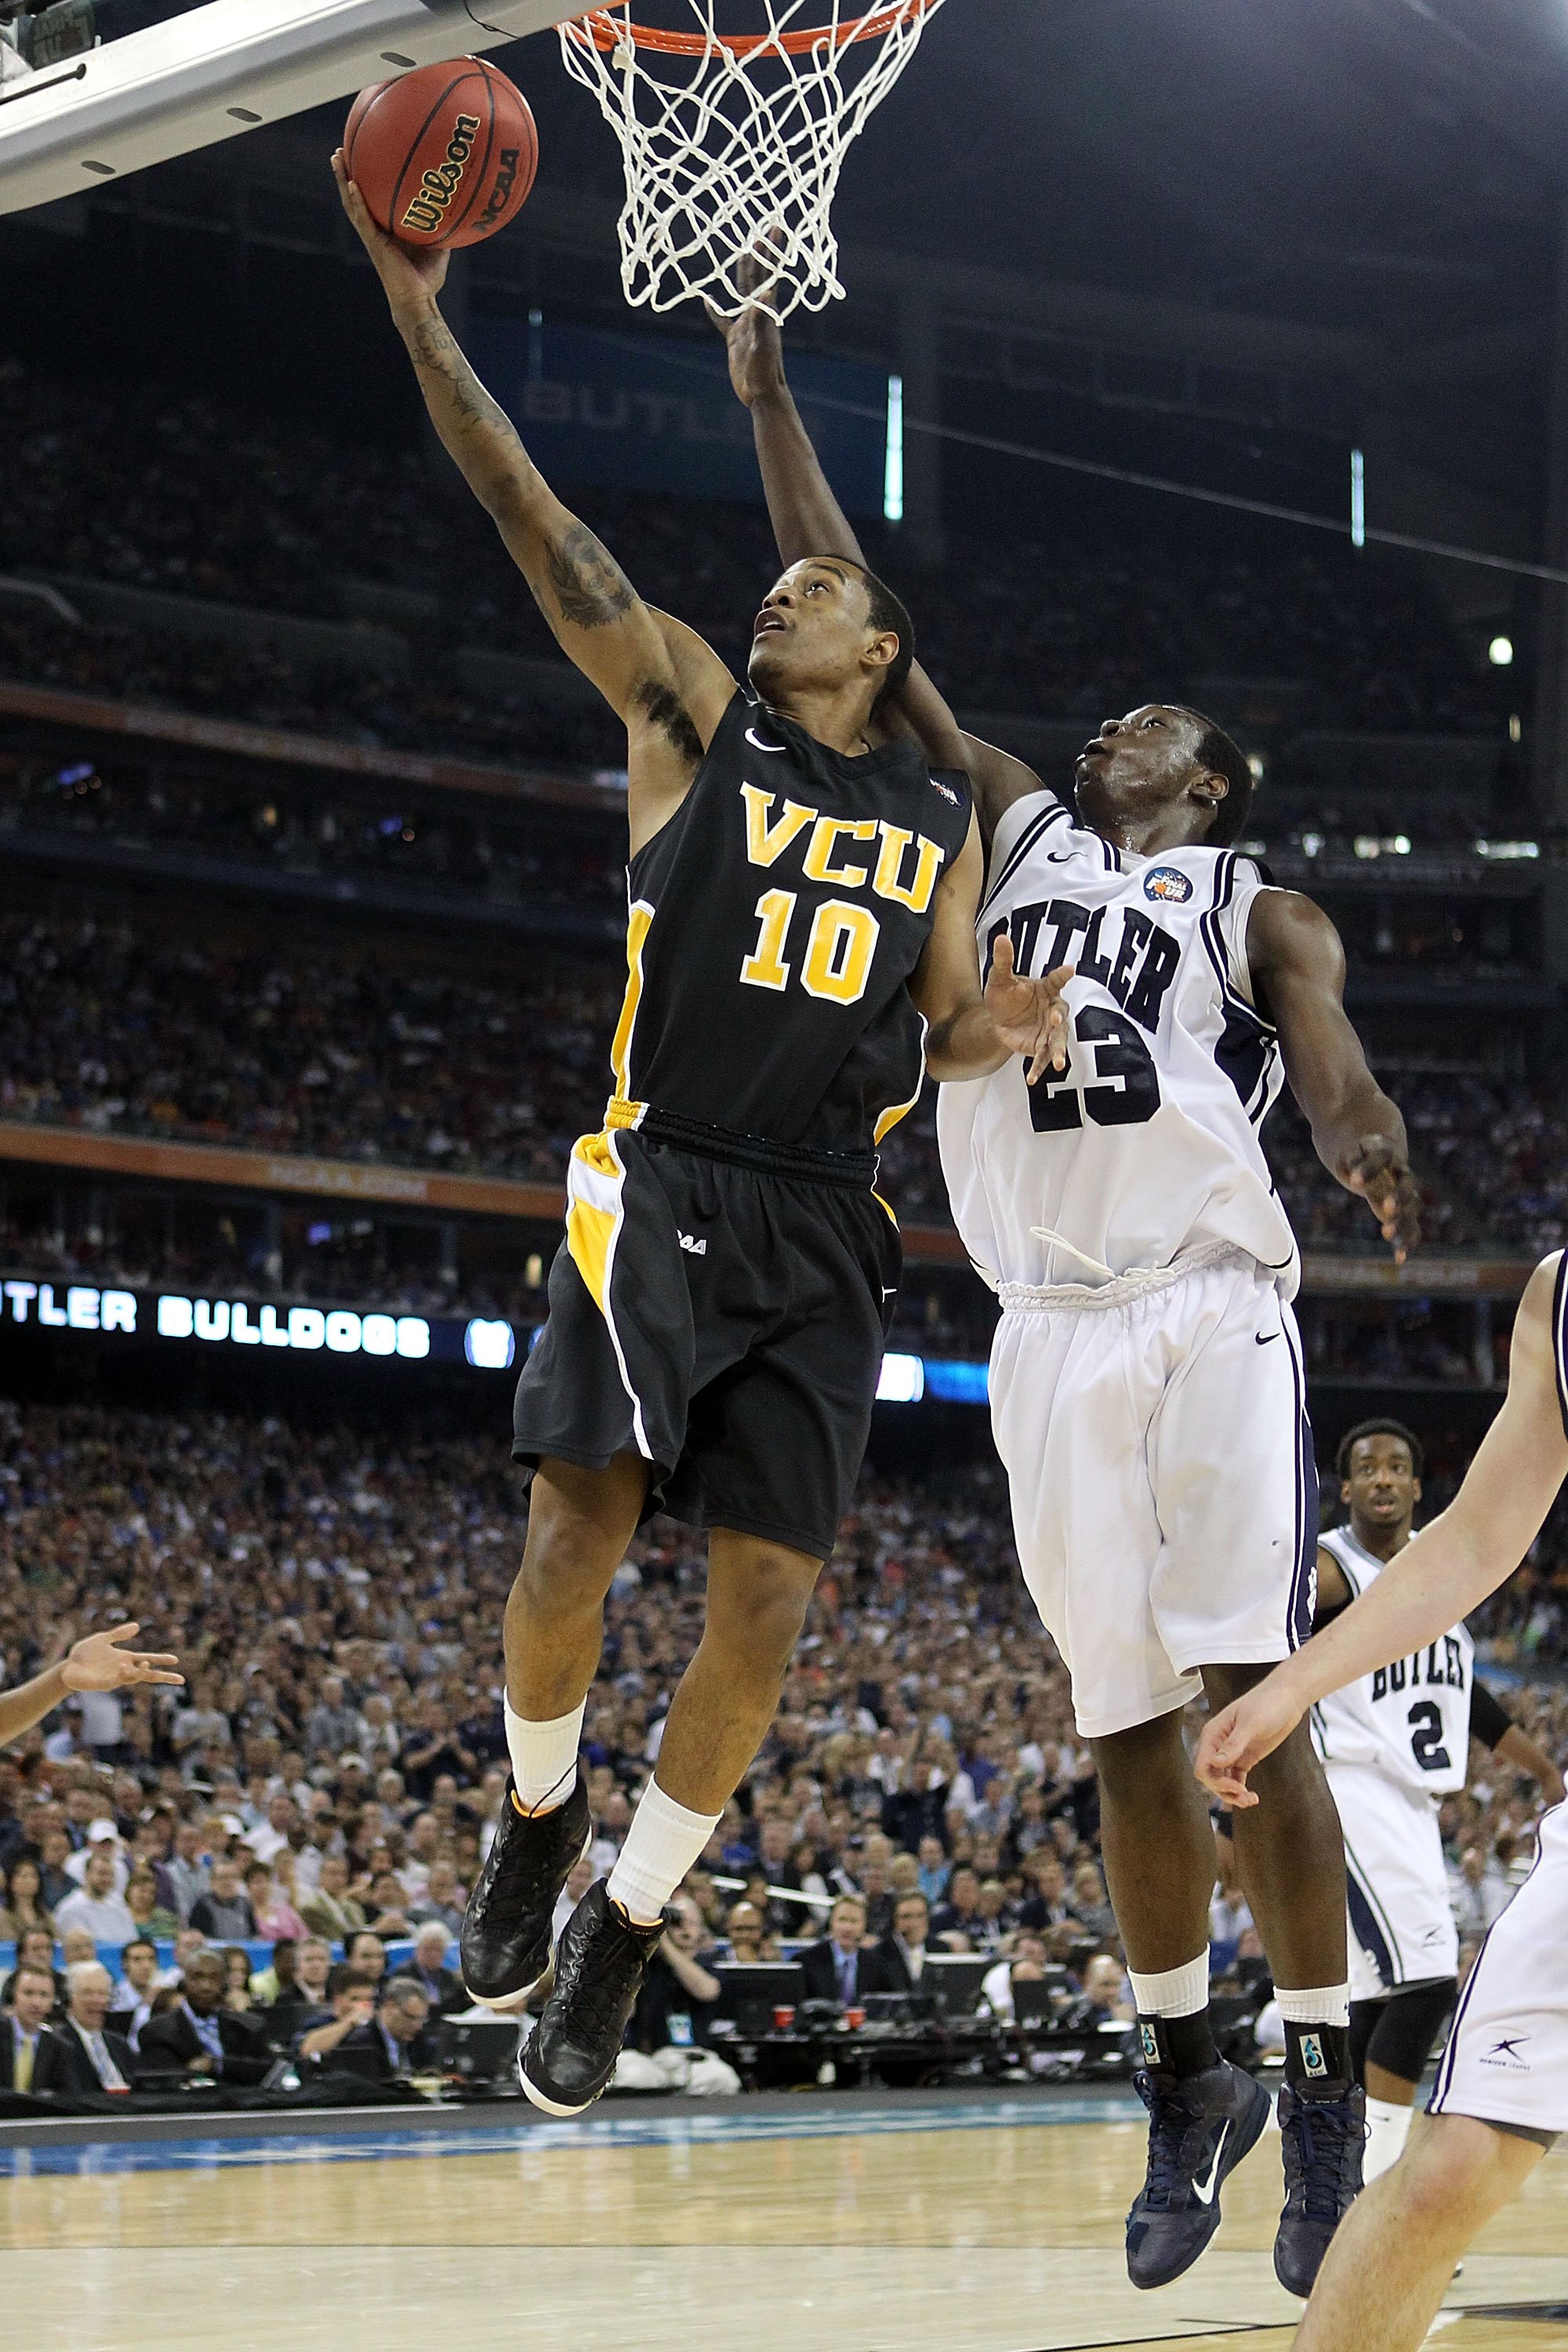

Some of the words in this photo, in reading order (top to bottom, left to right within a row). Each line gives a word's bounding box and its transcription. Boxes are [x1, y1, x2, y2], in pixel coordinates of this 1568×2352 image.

[401, 113, 481, 233] Wilson
[470, 147, 520, 233] NCAA
[739, 781, 945, 913] VCU
[739, 887, 880, 1006] 10
[1022, 1004, 1162, 1134] 23
[0, 1279, 137, 1333] TLER
[1408, 1700, 1451, 1770] 2
